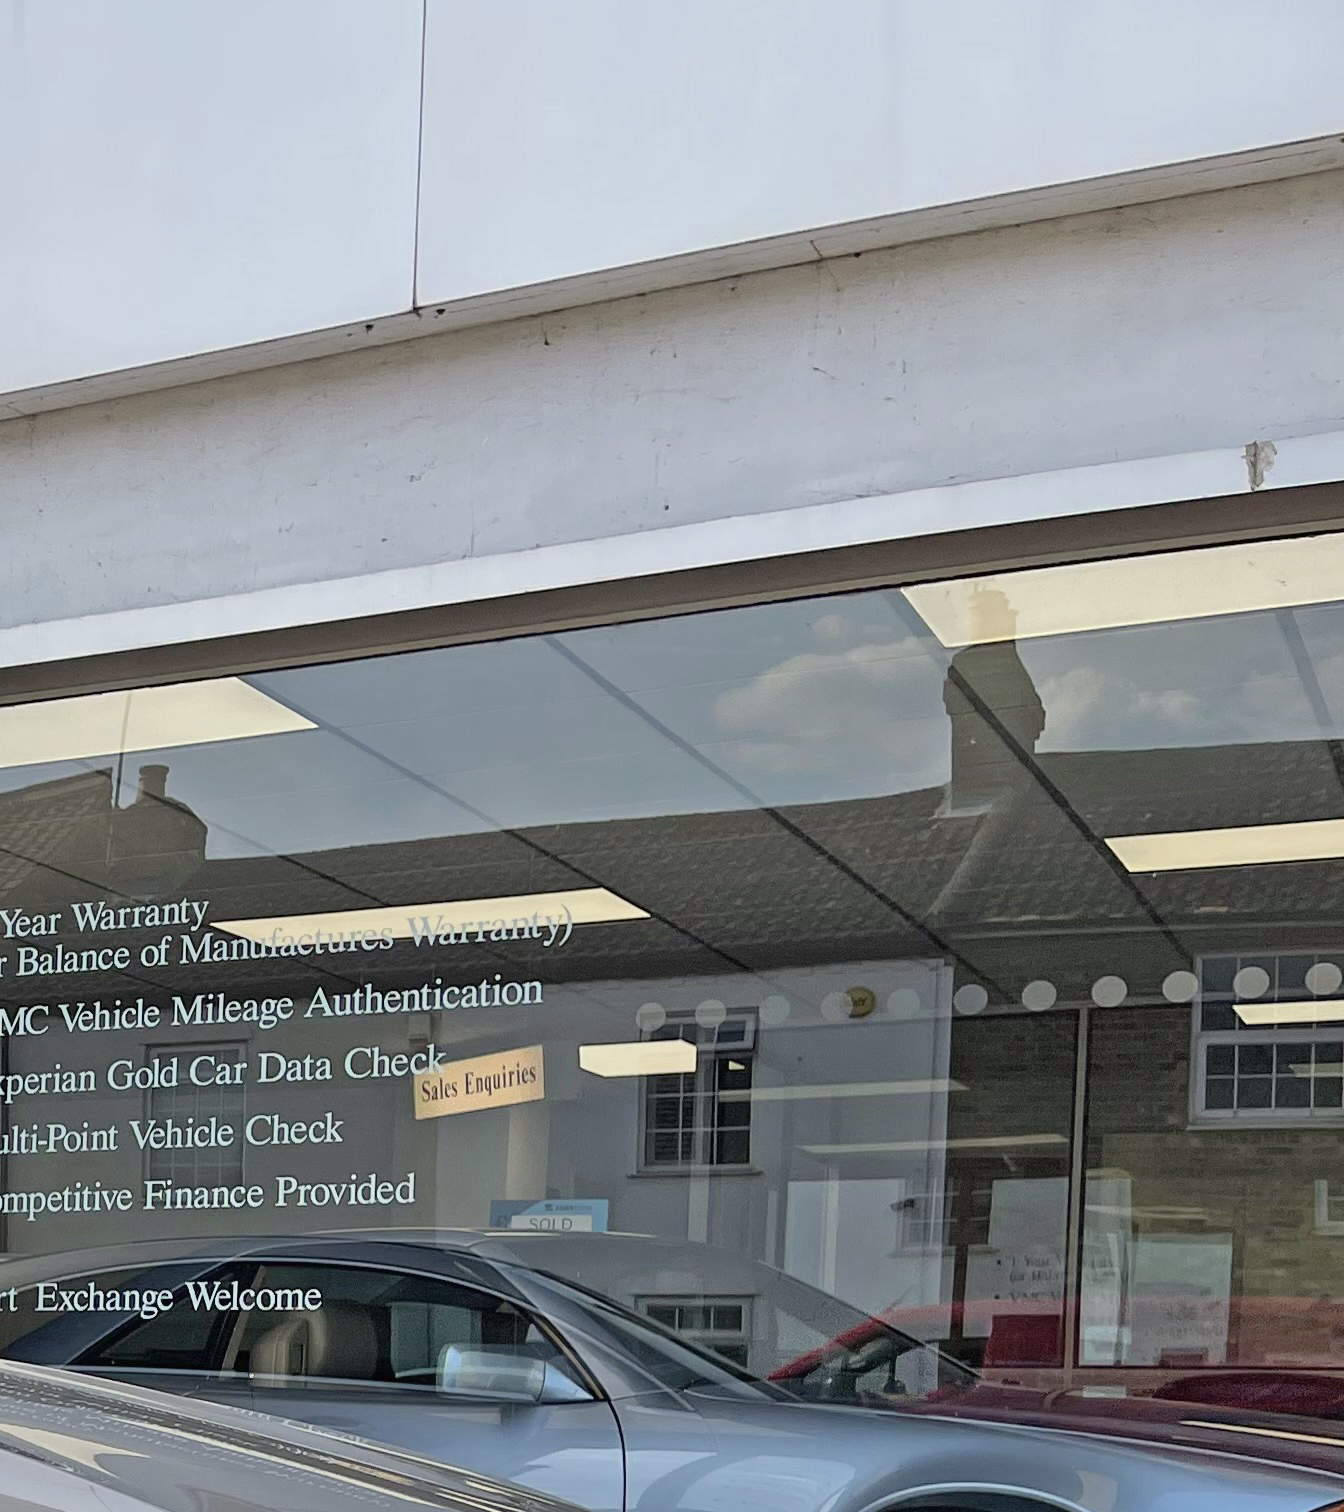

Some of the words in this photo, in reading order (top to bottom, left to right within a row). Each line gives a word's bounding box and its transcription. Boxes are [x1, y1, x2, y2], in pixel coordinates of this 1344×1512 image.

[71, 897, 210, 932] Warranty
[16, 944, 130, 977] Balance
[140, 935, 173, 968] of
[179, 926, 394, 965] Manufactures
[406, 903, 574, 948] Warranty)
[58, 998, 160, 1033] Vehicle
[170, 993, 295, 1030] Mileage
[304, 973, 544, 1019] Authentication
[107, 1056, 179, 1091] Gold
[189, 1055, 248, 1087] Car
[257, 1051, 333, 1084] Data
[344, 1044, 448, 1079] Check
[420, 1077, 459, 1103] Sales
[465, 1062, 538, 1097] Enquiries
[129, 1116, 234, 1150] Vehicle
[244, 1111, 345, 1147] Check
[143, 1178, 265, 1212] Finance
[274, 1172, 417, 1209] Provided
[529, 1217, 573, 1231] SOLD
[34, 1280, 175, 1320] Exchange
[184, 1280, 324, 1312] Welcome
